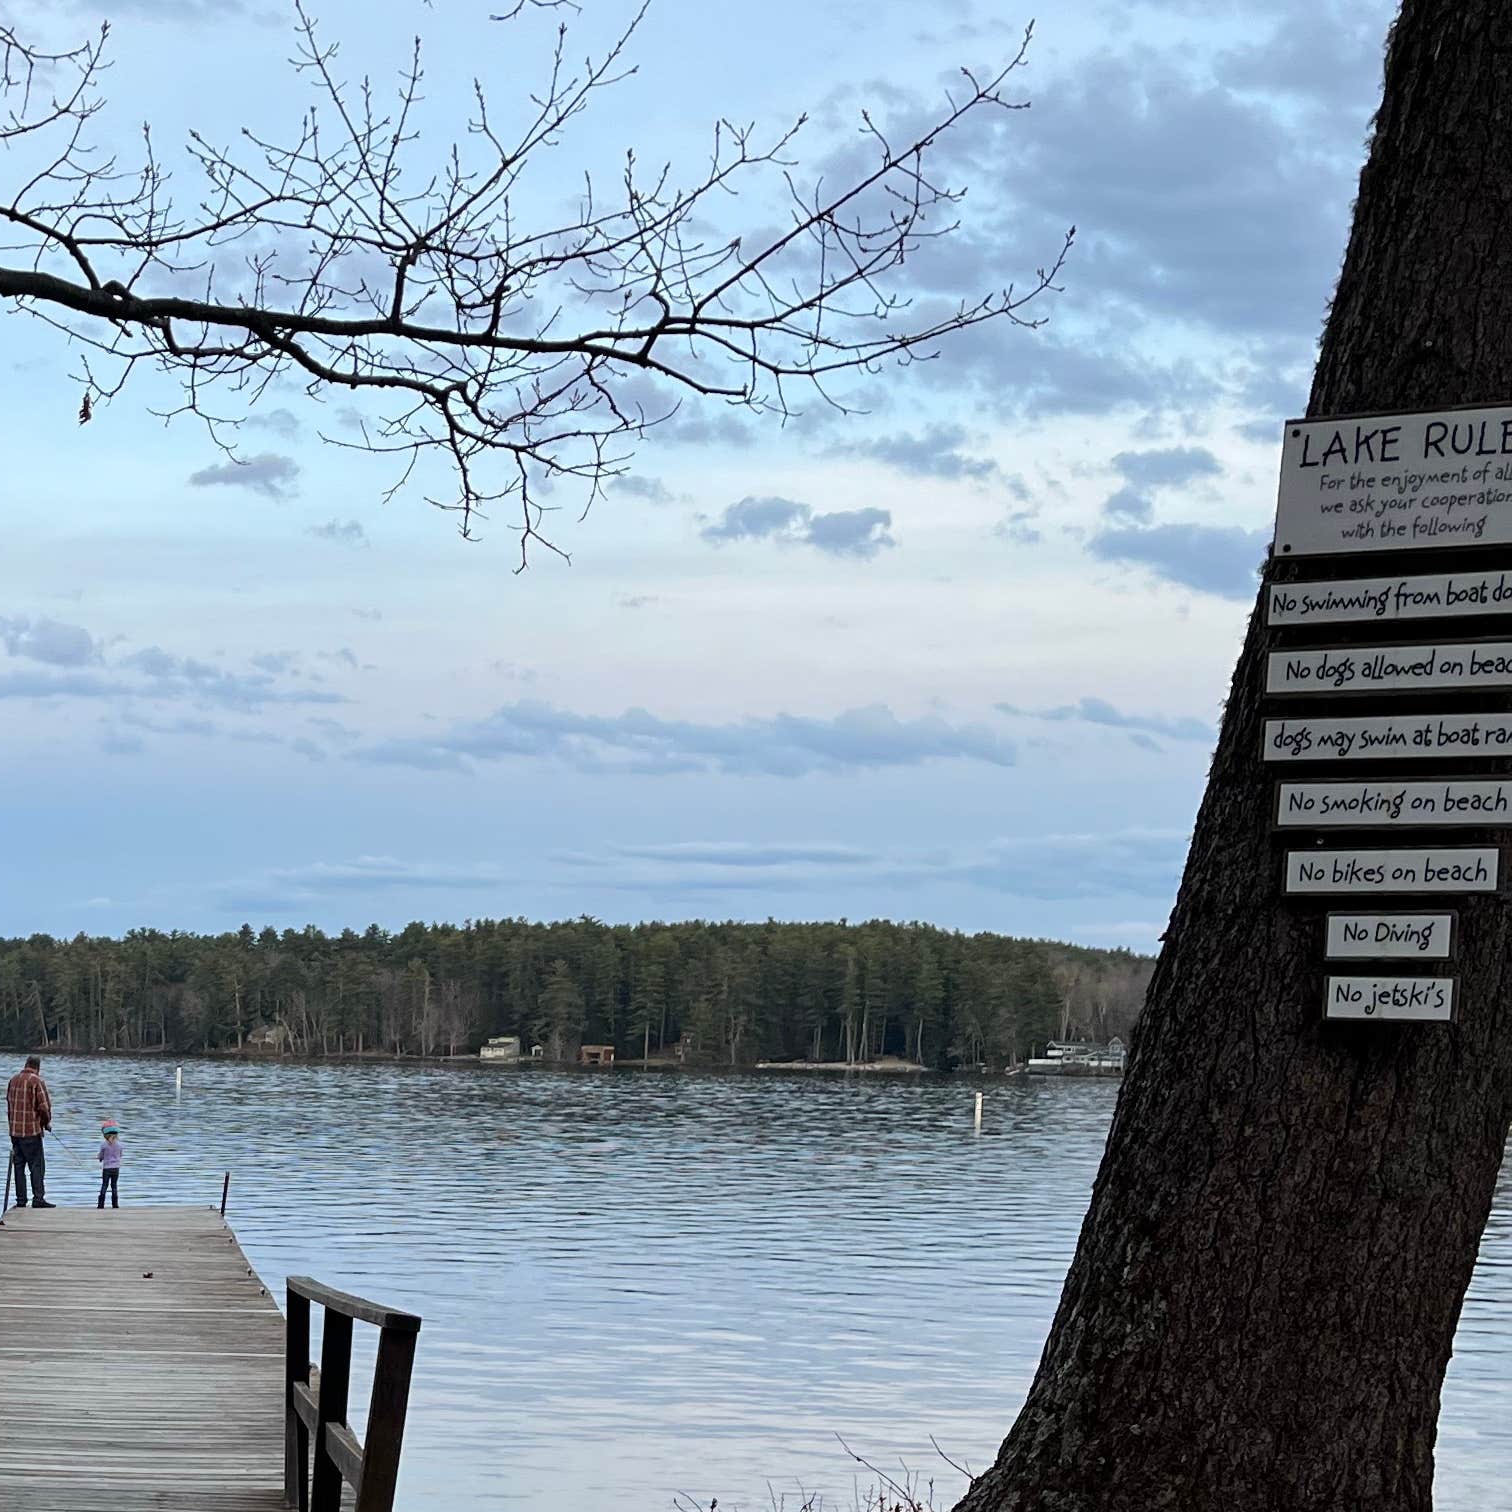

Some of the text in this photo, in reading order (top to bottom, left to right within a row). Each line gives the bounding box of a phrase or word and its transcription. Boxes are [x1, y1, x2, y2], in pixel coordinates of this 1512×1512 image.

[1299, 426, 1401, 468] LAKE
[1320, 474, 1344, 491] For
[1350, 472, 1375, 489] the
[1381, 467, 1467, 493] enjoyment
[1473, 462, 1492, 484] of
[1321, 503, 1343, 514] we
[1349, 494, 1374, 512] ask
[1375, 497, 1415, 517] your
[1342, 515, 1487, 539] with the following
[1272, 593, 1296, 613] No
[1300, 586, 1391, 615] swimming
[1394, 583, 1440, 611] from
[1446, 580, 1488, 603] boat
[1286, 660, 1310, 680] No
[1316, 654, 1355, 687] dogs
[1361, 649, 1435, 680] allowed
[1440, 663, 1463, 676] on
[1273, 723, 1312, 755] dogs
[1318, 732, 1355, 756] may
[1359, 727, 1407, 748] swim
[1413, 724, 1432, 747] at
[1438, 721, 1479, 747] boat
[1290, 786, 1507, 818] No smoking on beach
[1299, 858, 1487, 884] No bikes on beach
[1344, 922, 1434, 950] No Diving
[1336, 982, 1444, 1014] No jetski's
